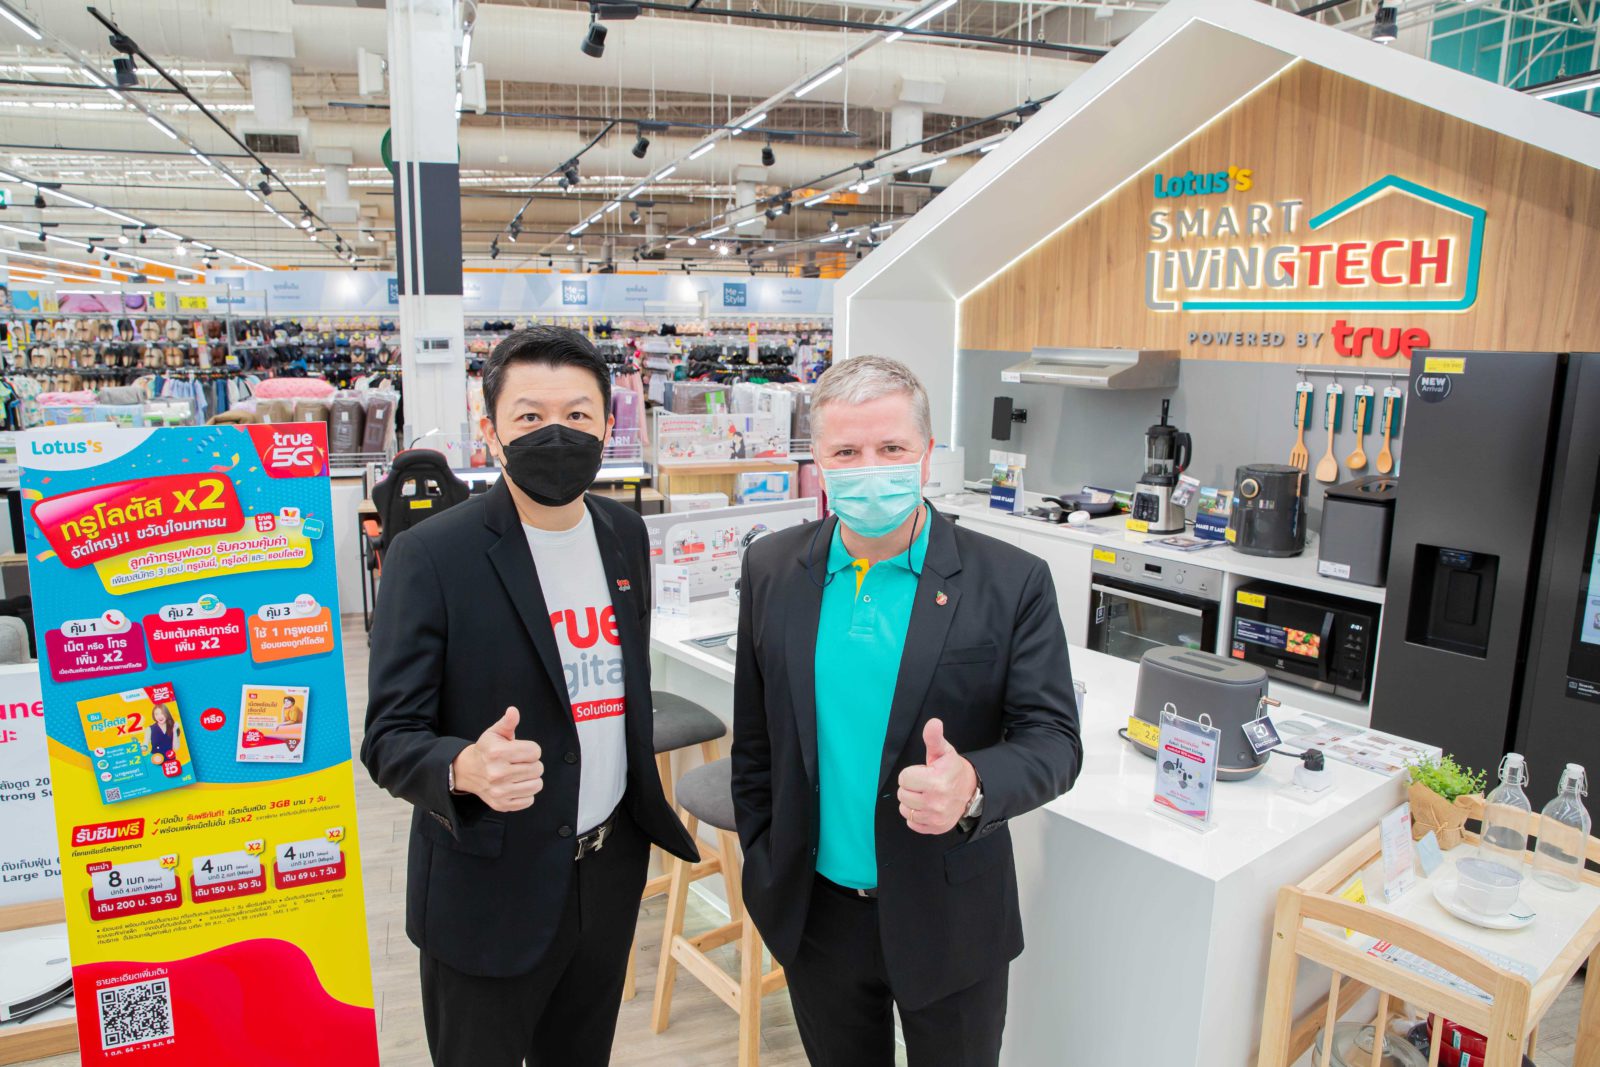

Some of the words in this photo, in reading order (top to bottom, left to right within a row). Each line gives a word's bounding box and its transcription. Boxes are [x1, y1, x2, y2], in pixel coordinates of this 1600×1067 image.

[1154, 165, 1253, 198] Lotus's
[1148, 199, 1303, 242] SMART
[1187, 331, 1285, 347] POWERED
[1296, 331, 1323, 347] BY
[1331, 320, 1430, 359] true
[1421, 377, 1446, 386] NEW
[1421, 385, 1444, 393] Arrival
[272, 431, 313, 446] true
[31, 439, 104, 455] Lotus's
[271, 446, 314, 468] 5G
[60, 496, 163, 542] ทรูโลตัส
[171, 478, 226, 514] x2
[1195, 523, 1209, 531] MAKE
[1214, 526, 1226, 534] LAST
[71, 531, 131, 559] จัดใหญ่!!
[137, 517, 227, 539] ขวัญใจมหาชน
[130, 545, 212, 570] ลูกค้าทรูมูฟเอช
[216, 536, 288, 553] รับความคุ้มค่า
[158, 568, 164, 576] 3
[168, 606, 184, 620] คุ้ม
[186, 607, 194, 617] 2
[266, 606, 281, 619] คุ้ม
[283, 607, 291, 616] 3
[70, 622, 87, 635] คุ้ม
[89, 622, 97, 632] 1
[153, 623, 240, 641] รับแต้มคลับการ์ด
[253, 626, 267, 638] ใช้
[271, 627, 279, 637] 1
[284, 621, 328, 638] ทรูพอยท์
[63, 640, 84, 652] เน็ต
[87, 642, 105, 650] หรือ
[107, 637, 128, 649] โทร
[175, 638, 196, 652] เพิ่ม
[201, 637, 221, 650] x2
[76, 652, 98, 665] เพิ่ม
[103, 650, 124, 663] x2
[576, 702, 624, 718] Solutions
[203, 713, 223, 724] หรือ
[1254, 737, 1279, 749] Electrolux
[269, 799, 291, 809] 3GB
[76, 821, 140, 844] รับซิมฟรี
[283, 846, 296, 861] 4
[201, 859, 214, 874] 4
[298, 872, 308, 880] 69
[325, 866, 337, 876] วัน
[3, 870, 40, 883] Large
[108, 870, 122, 887] 8
[211, 886, 226, 895] 150
[238, 882, 249, 890] 30
[250, 879, 262, 888] วัน
[116, 899, 136, 910] 200
[150, 896, 163, 905] 30
[164, 892, 178, 902] วัน
[142, 1043, 151, 1051] 31
